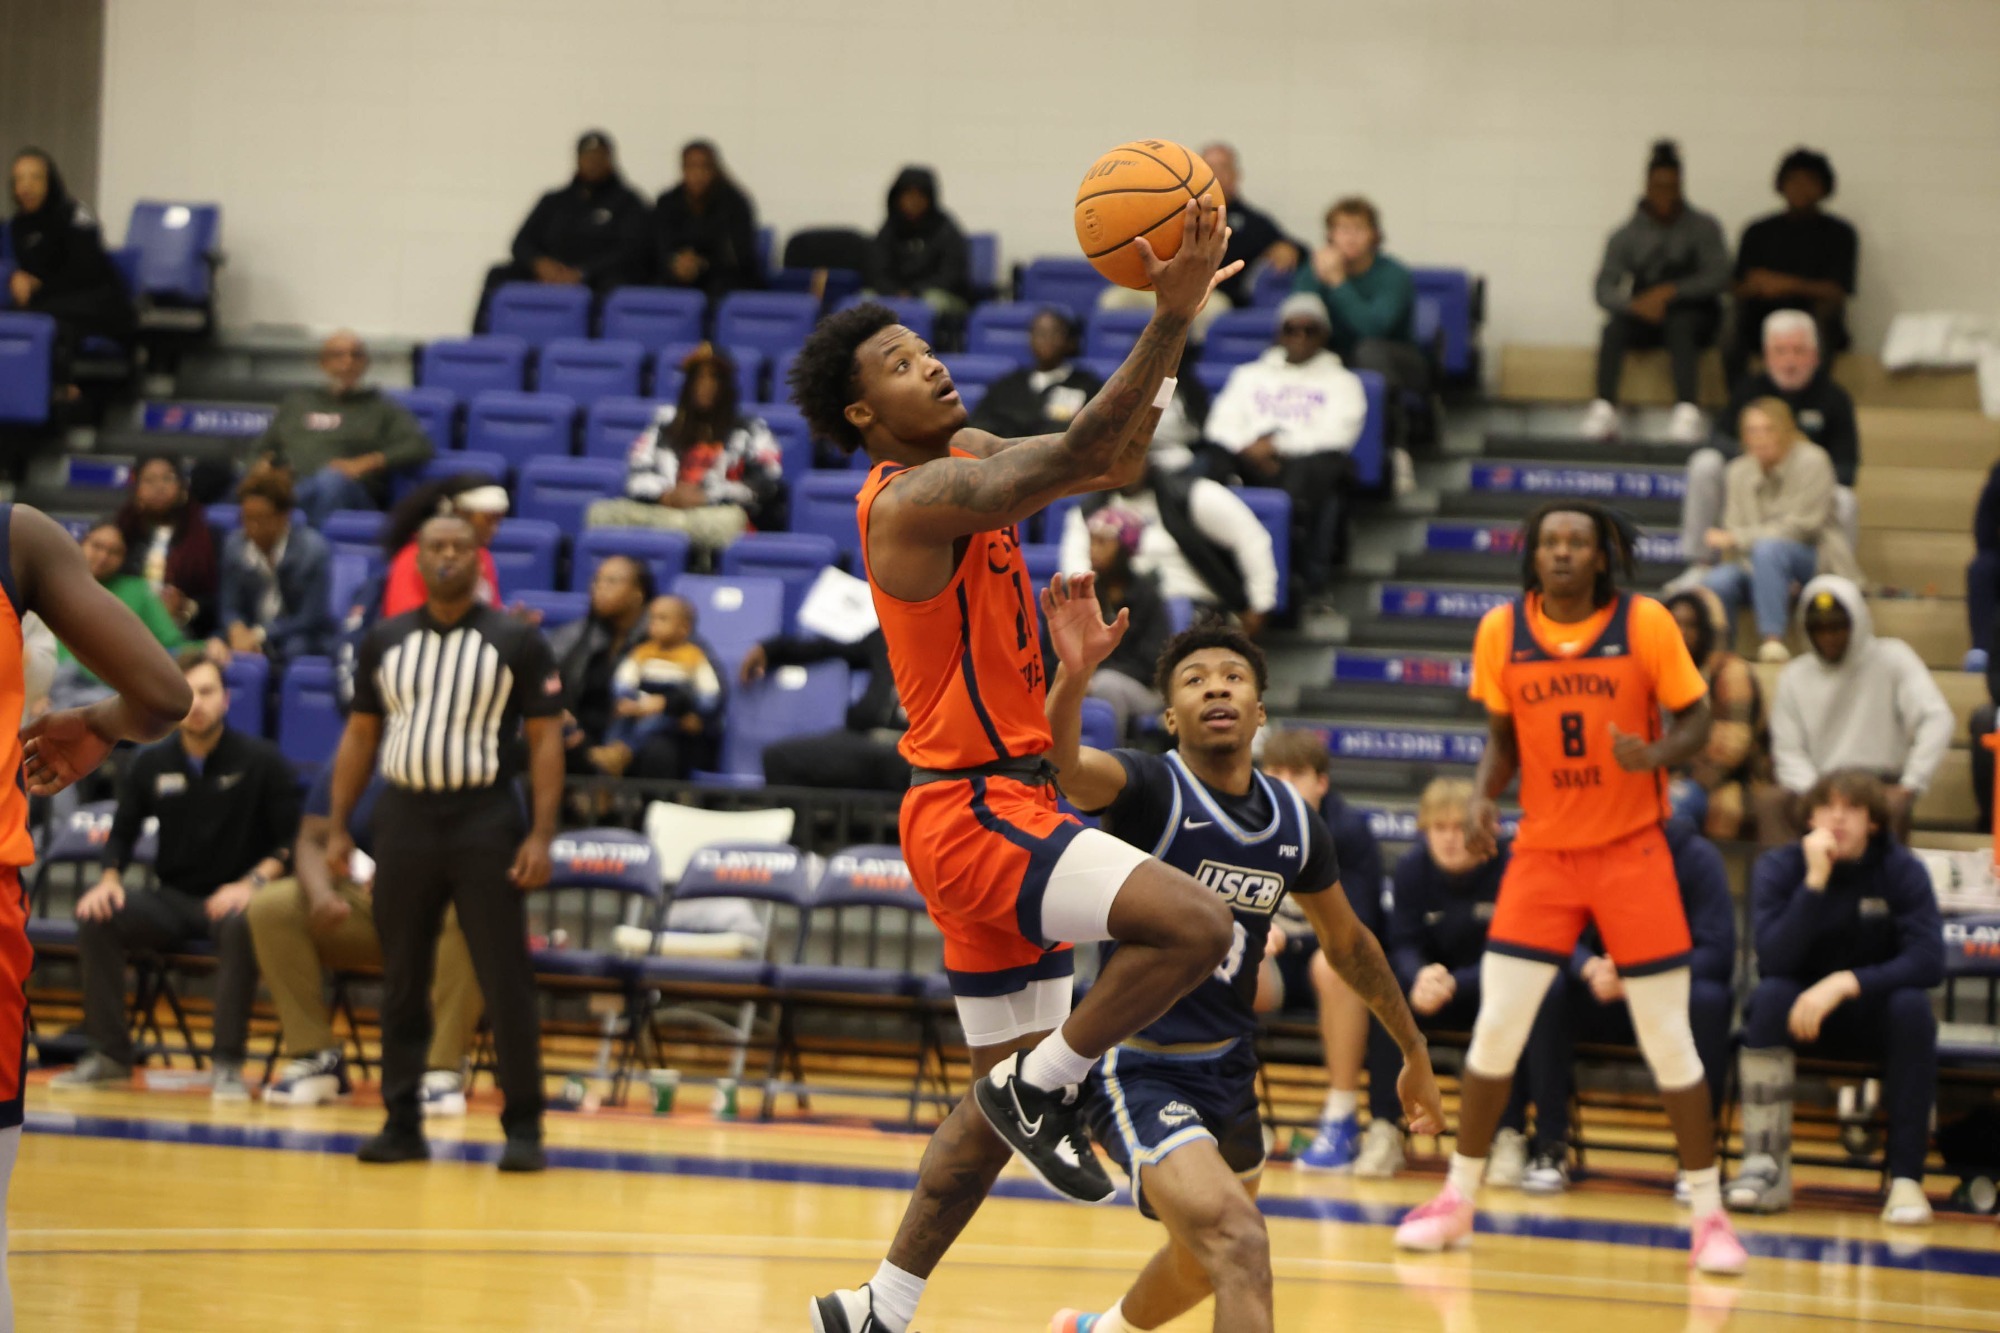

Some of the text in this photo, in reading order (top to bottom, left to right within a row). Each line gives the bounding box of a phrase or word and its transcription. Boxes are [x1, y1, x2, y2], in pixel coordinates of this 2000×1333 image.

[1520, 673, 1619, 704] CLAYTON
[1561, 712, 1586, 757] 8
[1553, 766, 1602, 788] STATE
[1199, 865, 1281, 908] USCB
